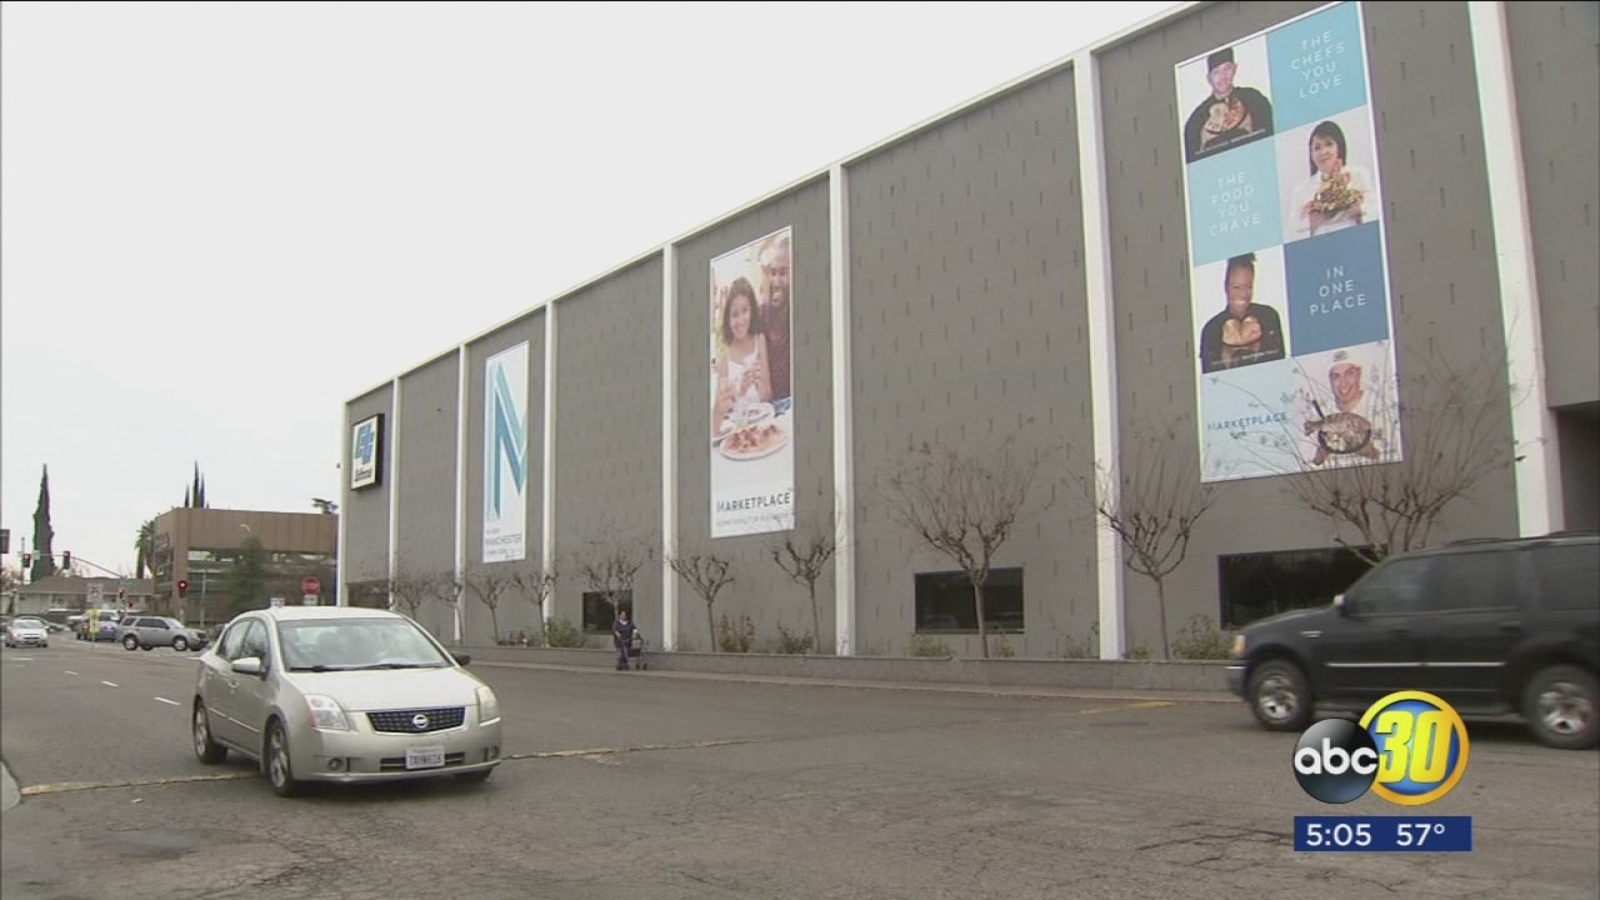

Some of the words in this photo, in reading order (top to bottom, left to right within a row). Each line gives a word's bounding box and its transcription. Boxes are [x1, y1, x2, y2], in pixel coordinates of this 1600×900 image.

[1302, 31, 1332, 51] THE
[1290, 42, 1345, 70] CHEFS
[1301, 61, 1336, 81] YOU
[1299, 74, 1342, 99] LOVE
[1216, 171, 1247, 188] THE
[1211, 184, 1254, 204] FOOD
[1217, 201, 1250, 219] YOU
[1209, 213, 1262, 236] CRAVE
[1325, 265, 1344, 279] IN
[1319, 279, 1354, 297] ONE
[1309, 294, 1367, 316] PLACE
[1207, 411, 1287, 431] MARKETPLACE
[716, 492, 790, 511] MARKETPLACE
